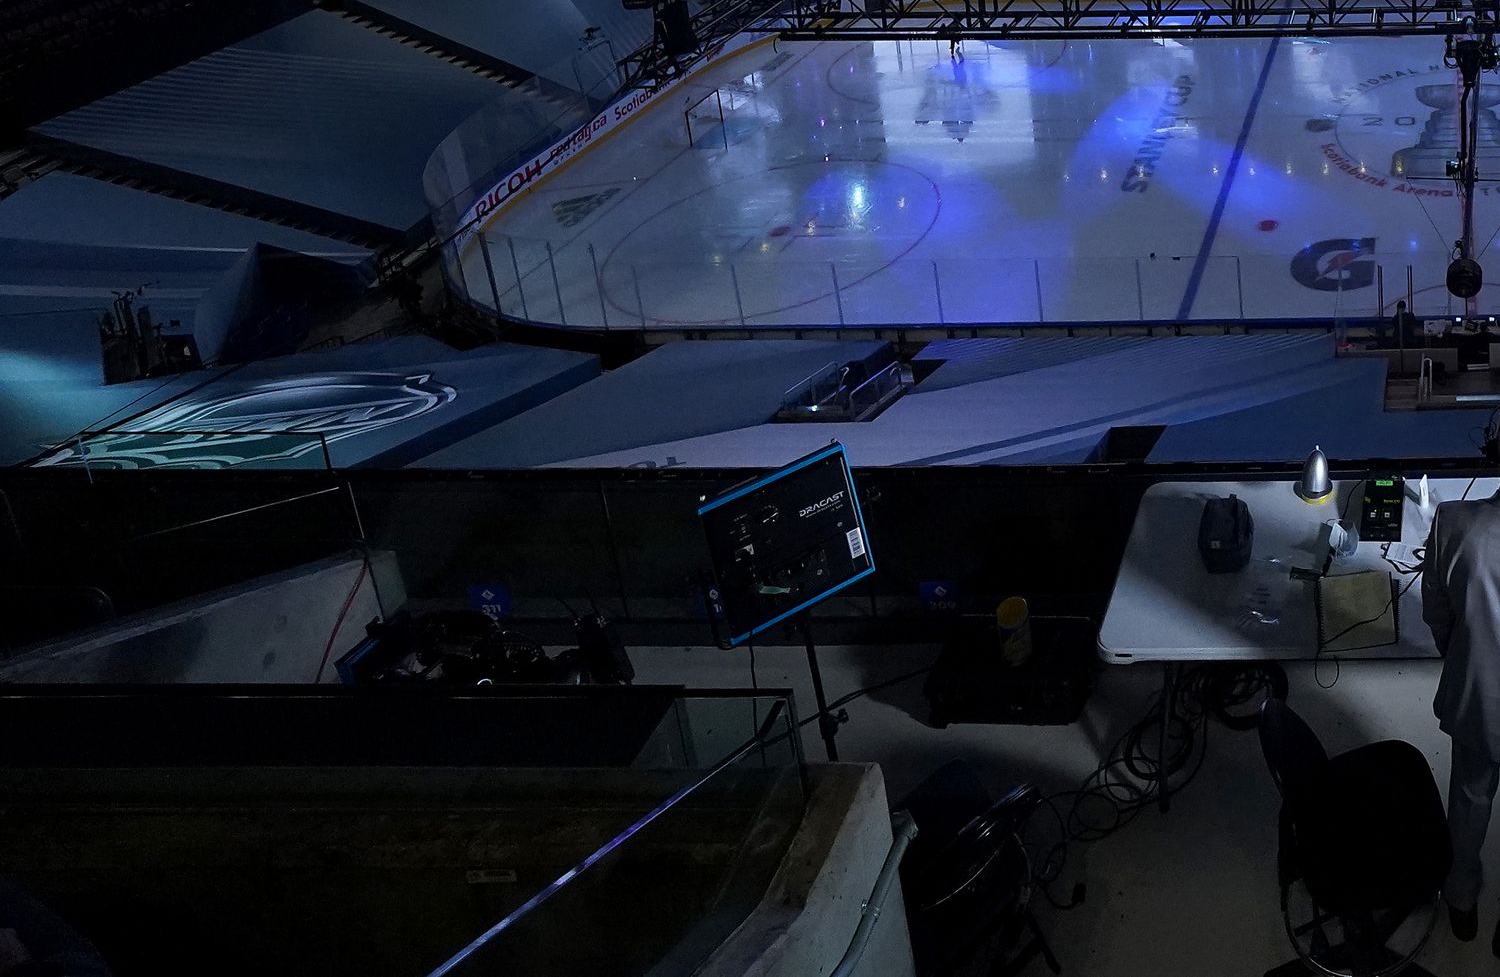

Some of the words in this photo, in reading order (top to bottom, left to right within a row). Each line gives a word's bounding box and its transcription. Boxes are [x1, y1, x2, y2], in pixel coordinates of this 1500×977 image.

[475, 159, 543, 221] RICOH
[1321, 141, 1386, 189] Scotiabank
[1392, 183, 1454, 198] Arena
[798, 490, 846, 518] DRACAST
